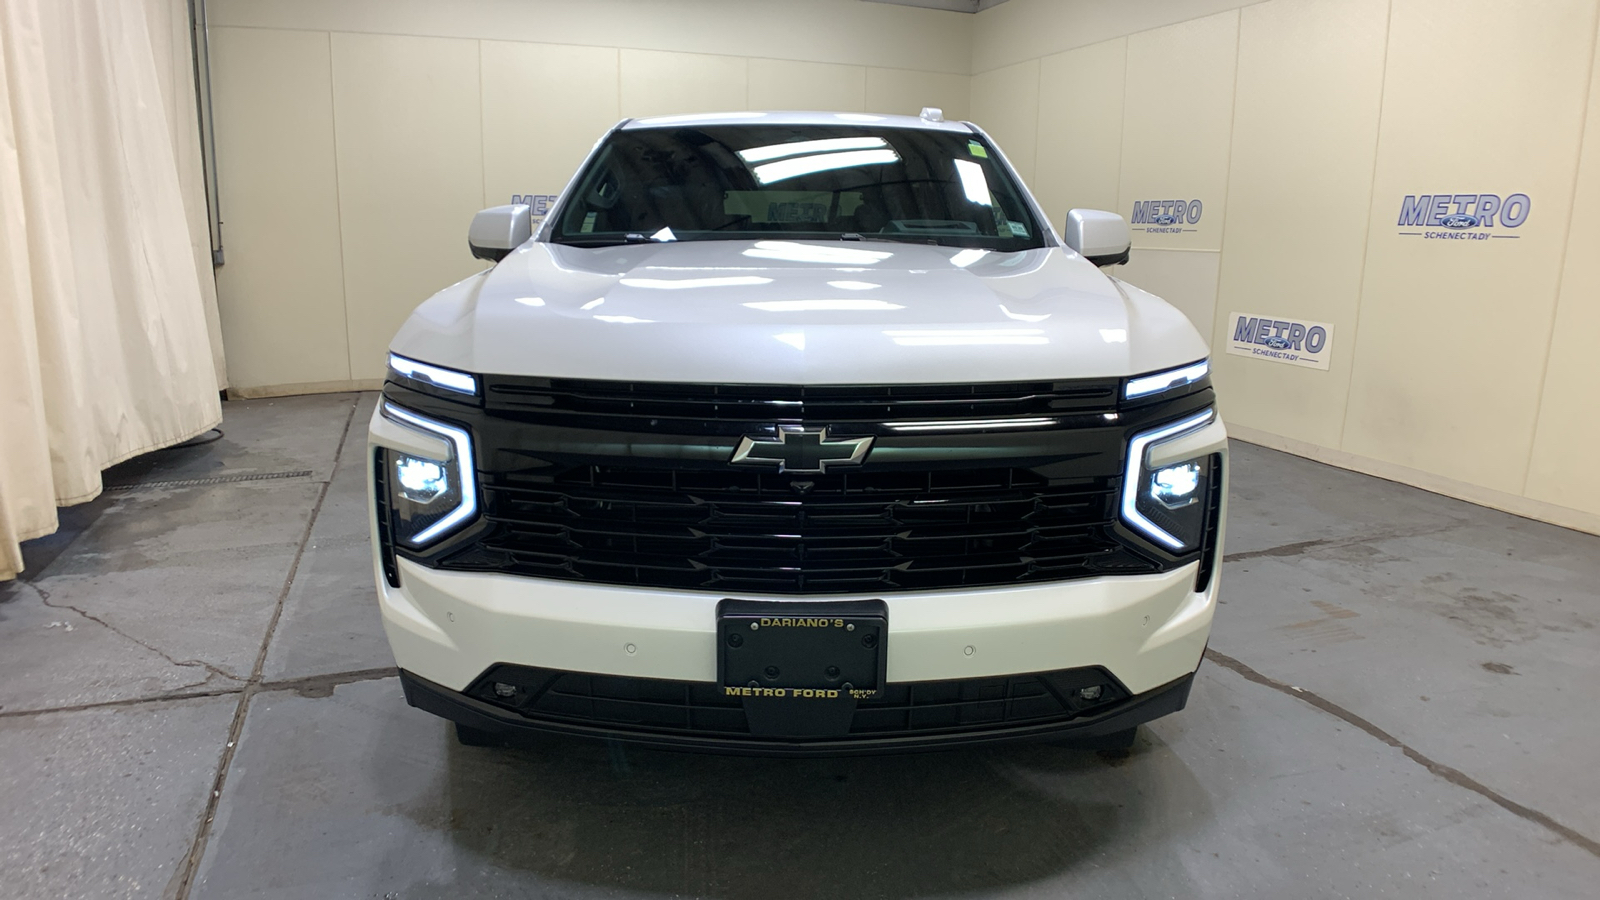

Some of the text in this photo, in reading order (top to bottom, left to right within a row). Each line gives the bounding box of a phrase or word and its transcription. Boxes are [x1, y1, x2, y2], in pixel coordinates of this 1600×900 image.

[1131, 199, 1202, 224] METRO
[1397, 193, 1531, 228] METRO
[1424, 231, 1491, 240] SCHENECTADY
[1233, 316, 1327, 354] METRO
[1252, 348, 1299, 361] SCHENECTADY
[760, 618, 844, 628] DARIANO'S
[725, 687, 839, 699] METRO FORD
